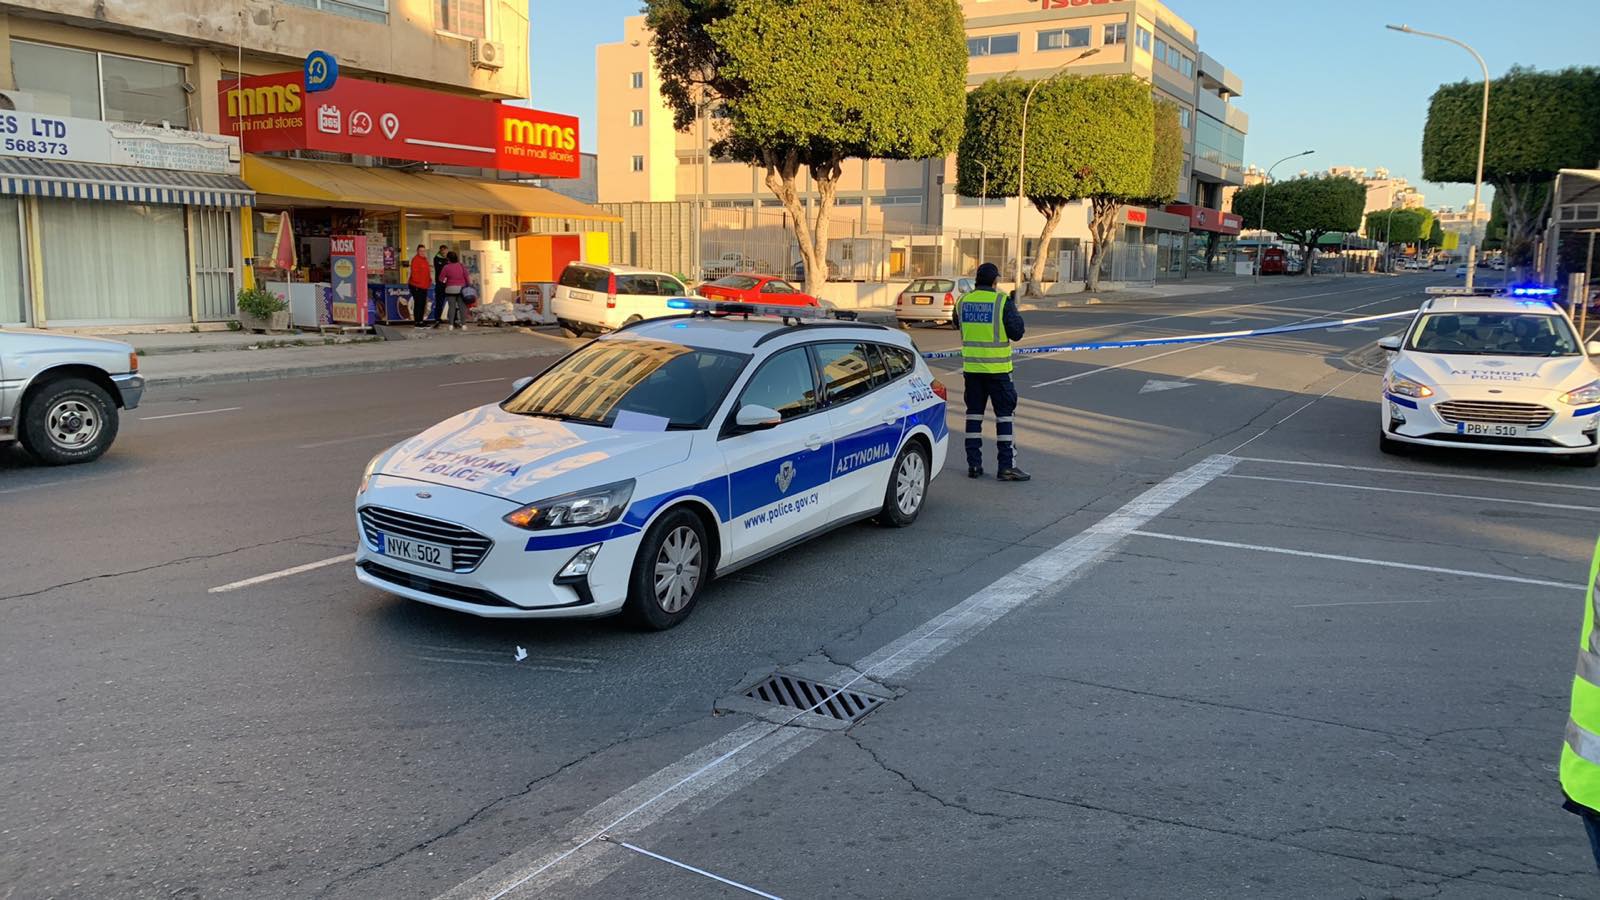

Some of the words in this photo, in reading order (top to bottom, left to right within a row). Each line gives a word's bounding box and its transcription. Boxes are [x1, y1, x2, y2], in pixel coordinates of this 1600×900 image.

[227, 84, 301, 117] mms
[32, 118, 66, 138] LTD
[232, 119, 252, 131] mni
[253, 117, 273, 130] mall
[274, 116, 303, 129] stores
[323, 116, 338, 128] 365
[504, 118, 576, 151] mms
[5, 138, 68, 155] 568373
[504, 145, 525, 156] mini
[527, 148, 548, 159] mall
[548, 150, 574, 163] stores
[332, 239, 355, 252] KIOSK
[965, 312, 989, 322] POLICE
[1467, 424, 1489, 434] PBY
[1495, 425, 1517, 436] 510
[836, 442, 891, 474] ΑΣΤΥΝΟΜΙΑ
[420, 462, 484, 482] POLICE
[744, 492, 819, 530] www.police.gov.cy
[387, 537, 411, 558] NYK
[417, 544, 441, 565] 502
